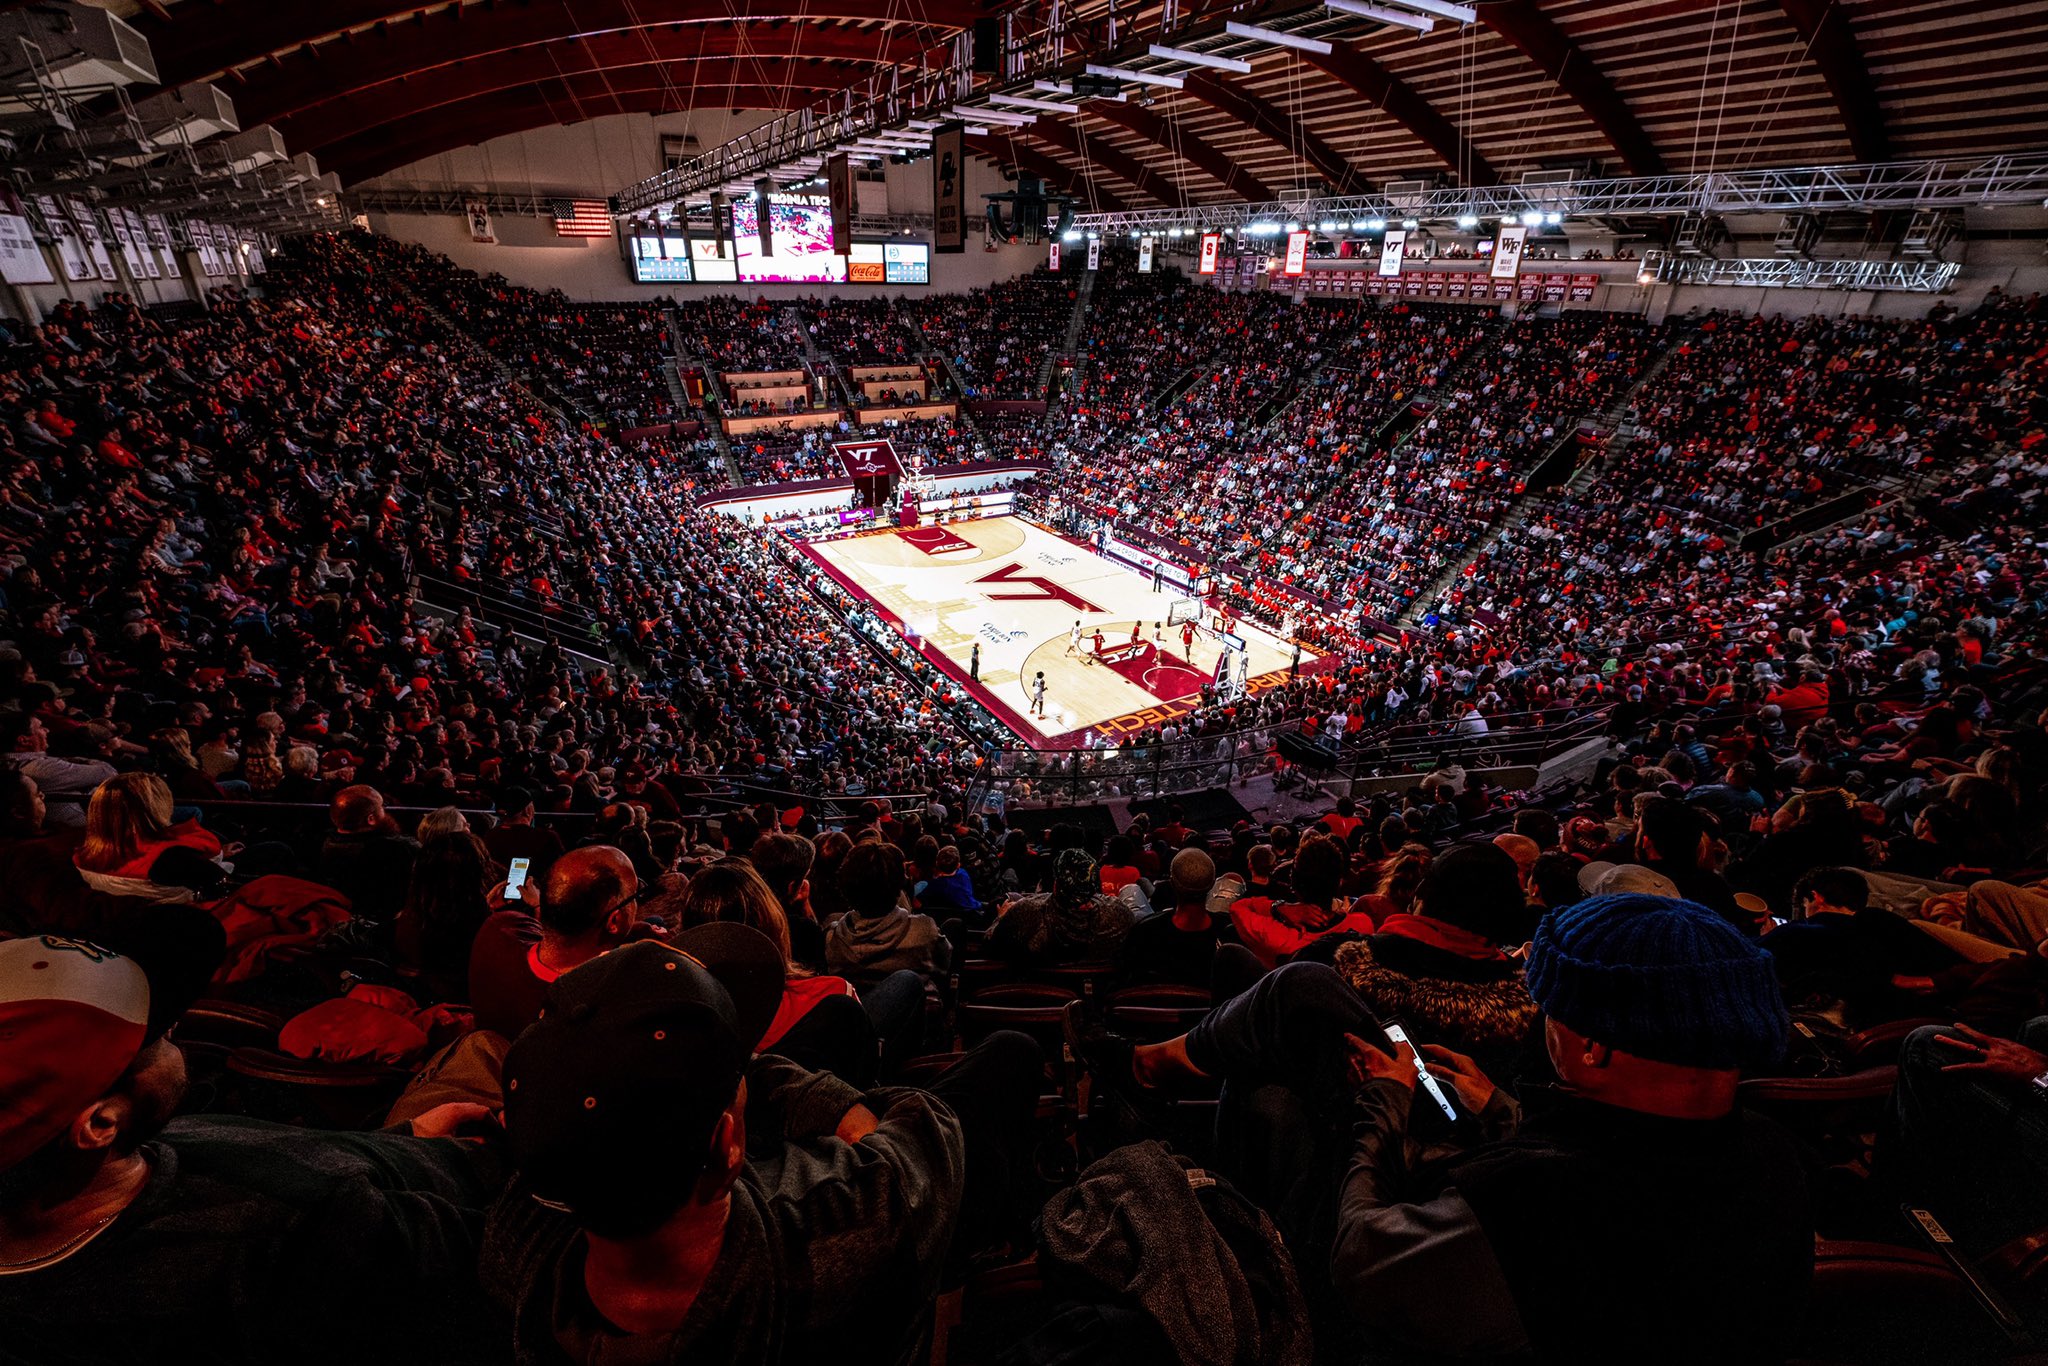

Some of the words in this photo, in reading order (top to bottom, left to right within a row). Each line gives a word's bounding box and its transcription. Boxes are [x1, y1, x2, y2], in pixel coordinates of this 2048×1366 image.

[767, 193, 808, 206] IRGINIA
[1206, 242, 1213, 255] S
[1386, 241, 1402, 252] VT
[847, 448, 878, 461] VT
[929, 542, 968, 553] ACC
[1095, 703, 1188, 737] TECH
